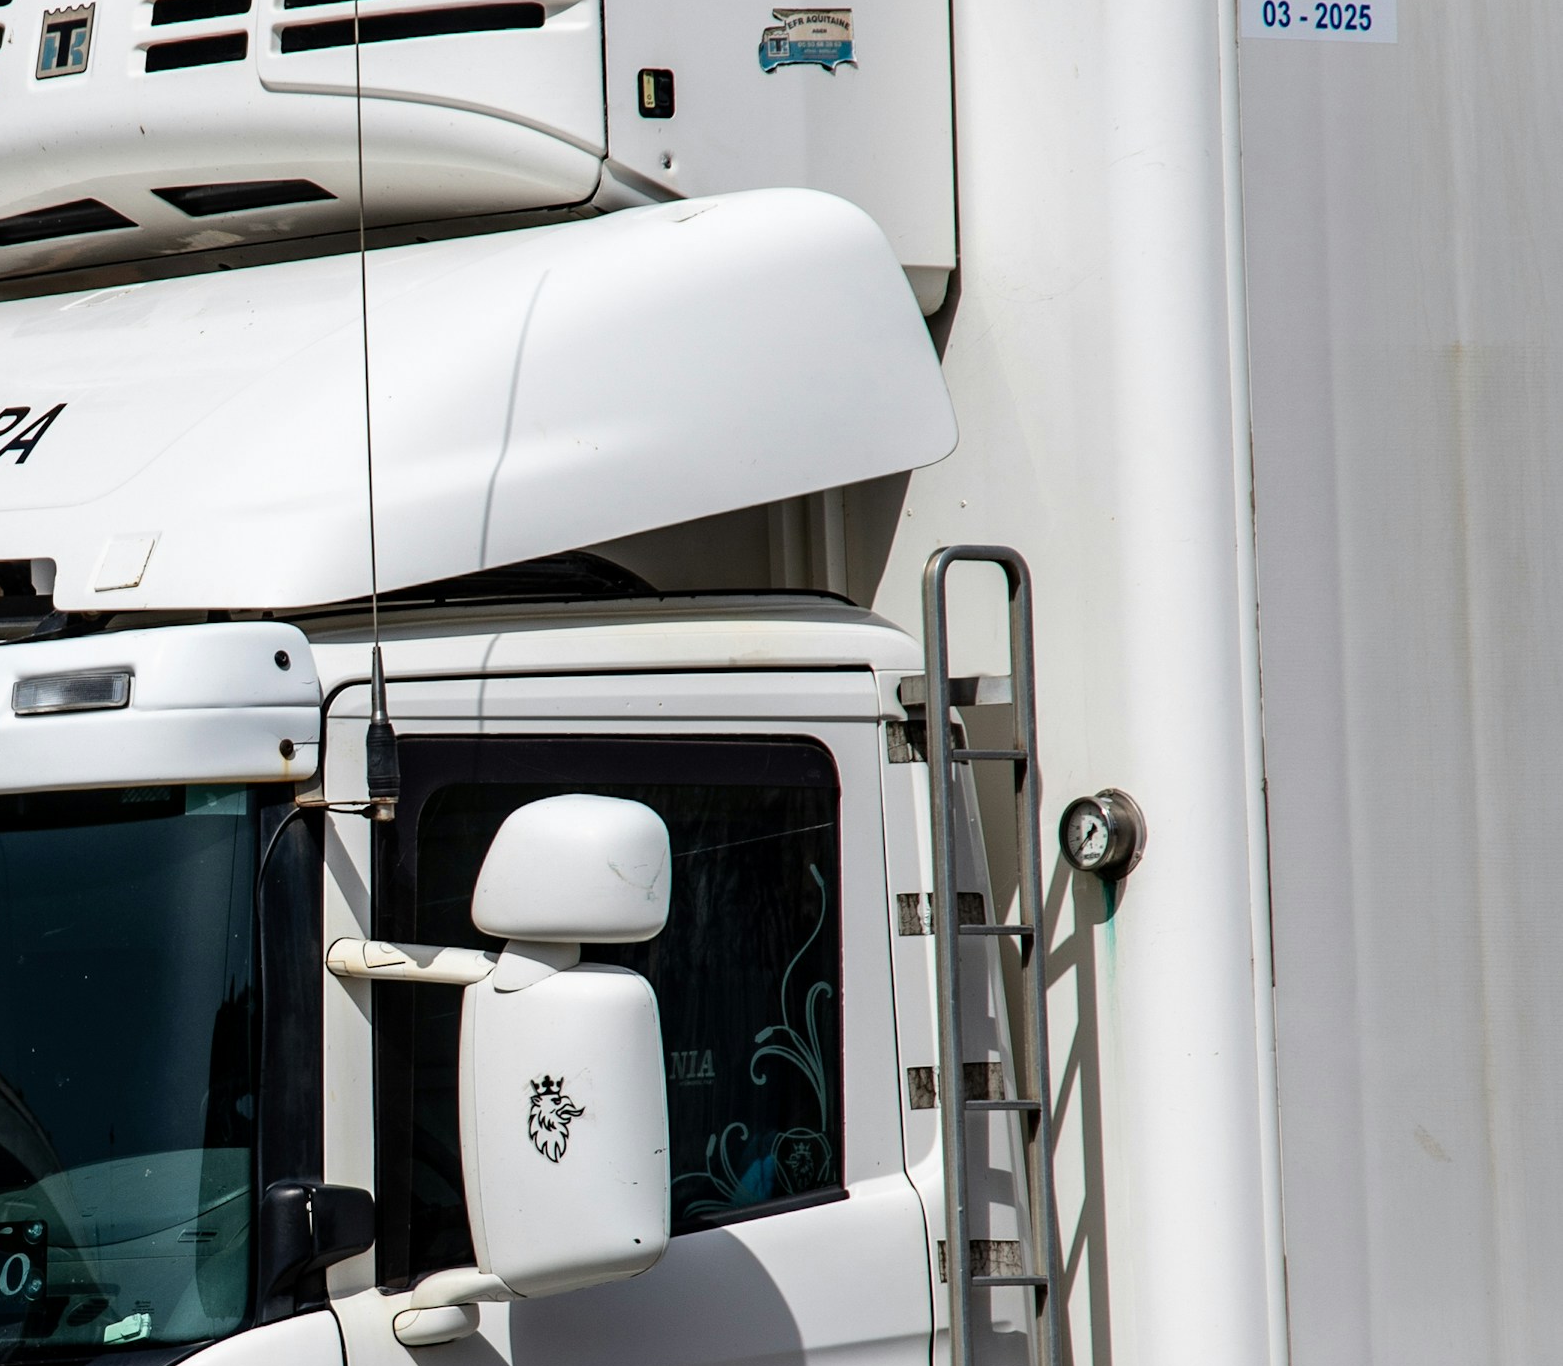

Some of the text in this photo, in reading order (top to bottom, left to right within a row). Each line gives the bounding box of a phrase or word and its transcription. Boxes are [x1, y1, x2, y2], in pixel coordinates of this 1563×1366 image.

[787, 15, 851, 31] EFR AQUITAINE
[1263, 0, 1291, 28] 03
[1314, 2, 1372, 31] 2025
